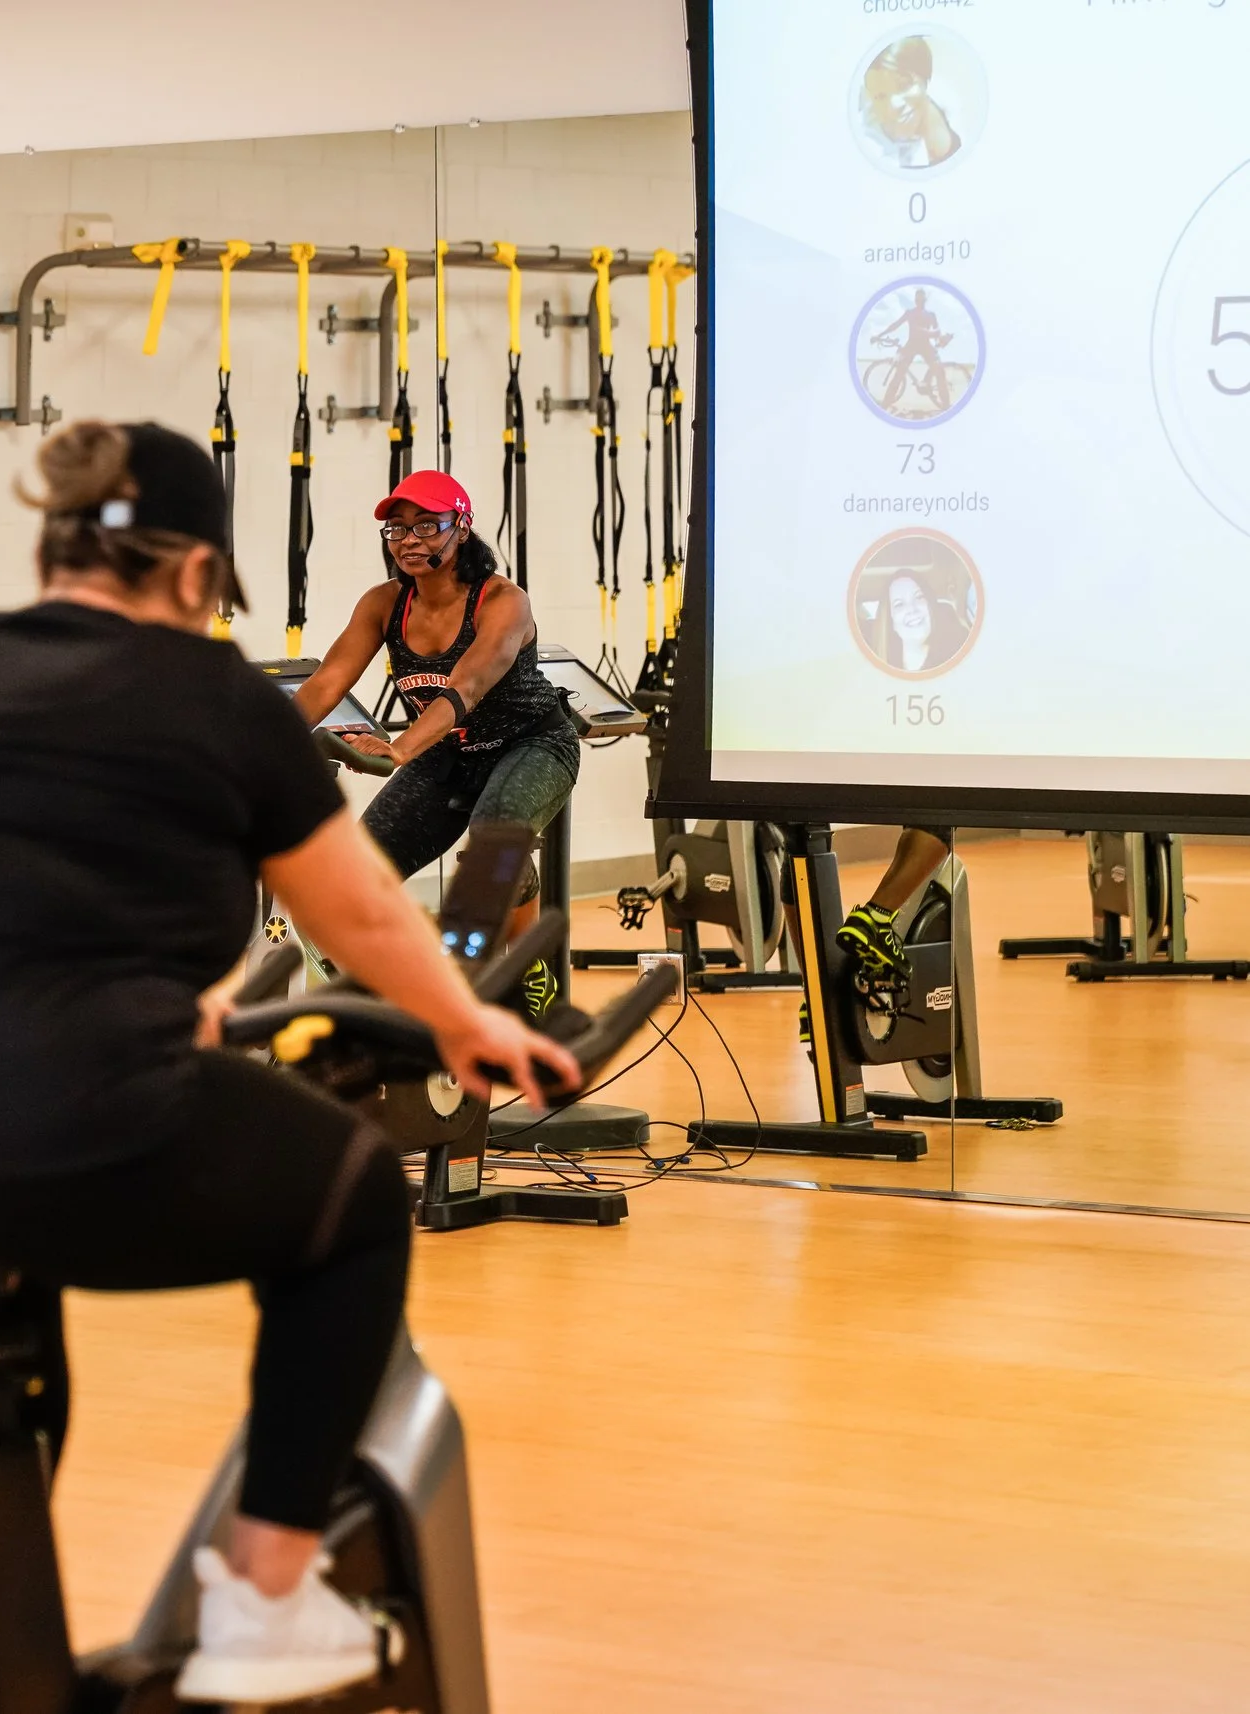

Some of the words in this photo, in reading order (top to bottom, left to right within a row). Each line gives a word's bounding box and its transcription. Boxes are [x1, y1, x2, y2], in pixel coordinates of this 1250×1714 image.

[909, 192, 926, 223] 0
[864, 239, 970, 265] arandag10
[1207, 295, 1250, 395] 5
[896, 442, 935, 474] 73
[843, 491, 989, 517] dannareynolds
[396, 673, 449, 692] HITBUD
[886, 694, 945, 726] 156
